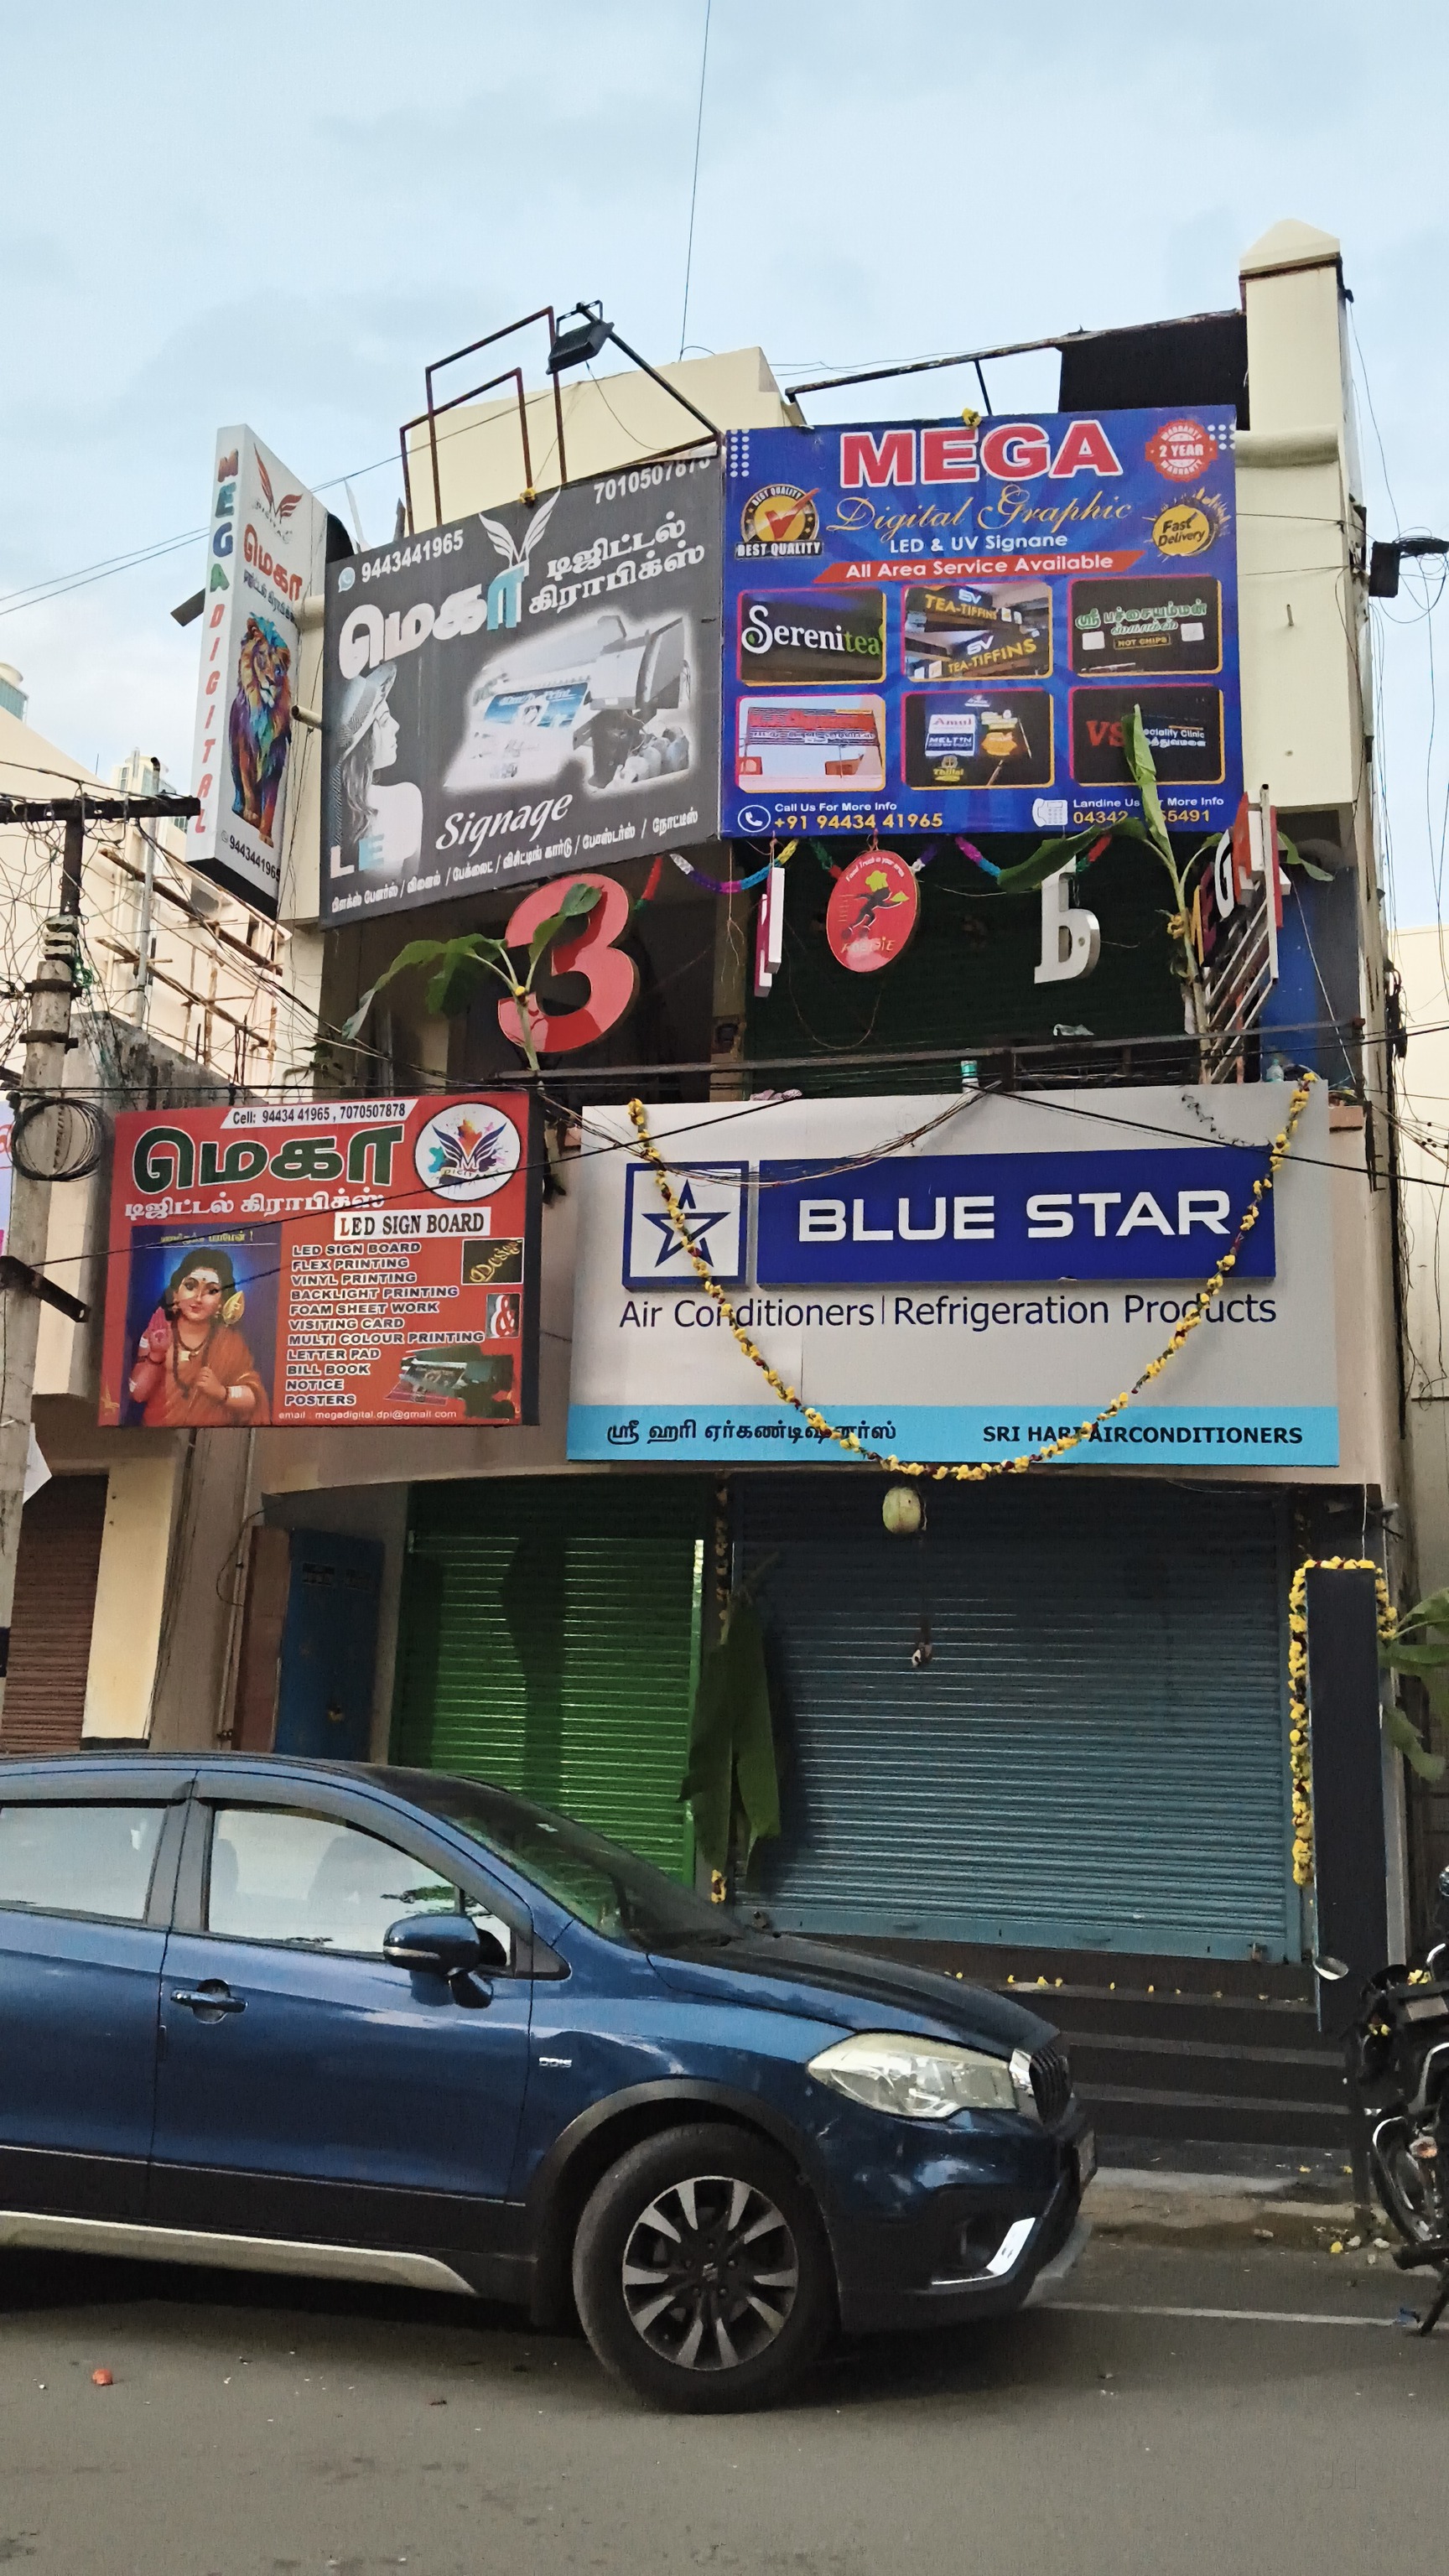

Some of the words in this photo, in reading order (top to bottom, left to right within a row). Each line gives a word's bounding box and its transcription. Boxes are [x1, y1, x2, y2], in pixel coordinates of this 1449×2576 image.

[840, 419, 1124, 488] MEGA
[1159, 445, 1167, 457] 2
[1171, 444, 1204, 457] YEAR
[751, 490, 769, 506] BEST
[771, 486, 802, 500] QUALITY
[825, 496, 974, 543] Digital
[977, 484, 1132, 533] Graphic
[1162, 512, 1199, 534] Fast
[547, 511, 686, 580] டிஜிட்டல்
[890, 538, 924, 553] LED
[931, 538, 943, 552] &
[951, 536, 979, 550] UV
[985, 534, 1068, 553] Signane
[1158, 530, 1206, 547] Delivery
[361, 529, 464, 583] 9443441965
[738, 543, 767, 557] BEST
[771, 542, 821, 556] QUALITY
[243, 523, 303, 601] மெகா
[846, 563, 870, 579] All
[877, 561, 927, 577] Area
[933, 559, 1008, 576] Service
[1015, 554, 1114, 572] Available
[528, 539, 705, 614] கிராபிக்ஸ்
[741, 605, 880, 655] Serenitea
[948, 638, 1037, 673] TEA-TIFFINS
[775, 803, 792, 813] Call
[800, 802, 816, 812] Us
[819, 802, 839, 812] For
[842, 802, 871, 812] More
[875, 802, 897, 811] Info
[1124, 798, 1140, 808] Us
[1167, 797, 1197, 807] More
[1201, 797, 1224, 806] Info
[435, 794, 573, 857] Signage
[775, 815, 807, 830] +91
[817, 814, 876, 829] 94434
[883, 813, 943, 828] 41965
[232, 1110, 257, 1125] Cell:
[262, 1109, 294, 1124] 94434
[297, 1108, 330, 1122] 41965
[340, 1103, 406, 1119] 7070507878
[132, 1124, 405, 1195] மெகா
[125, 1192, 235, 1221] டிஜிட்டல்
[240, 1187, 386, 1218] கிராபிக்ஸ்
[340, 1217, 376, 1236] LED
[382, 1215, 422, 1235] SIGN
[427, 1213, 485, 1233] BOARD
[798, 1195, 995, 1242] BLUE
[1026, 1190, 1231, 1239] STAR
[293, 1244, 322, 1257] LED
[325, 1243, 364, 1255] SIGN
[367, 1241, 422, 1254] BOARD
[292, 1259, 331, 1271] FLEX
[334, 1258, 409, 1270] PRINTING
[291, 1274, 338, 1286] VINYL
[341, 1272, 418, 1285] PRINTING
[291, 1288, 380, 1301] BACKLIGHT
[382, 1286, 460, 1299] PRINTING
[289, 1304, 334, 1316] FOAM
[335, 1302, 387, 1315] SHEET
[391, 1301, 440, 1314] WORK
[619, 1300, 663, 1328] Air
[894, 1293, 1109, 1332] Refrigeration
[288, 1319, 358, 1331] VISITING
[361, 1317, 405, 1329] CARD
[288, 1334, 337, 1346] MULTI
[339, 1332, 404, 1345] COLOUR
[408, 1331, 486, 1344] PRINTING
[287, 1348, 348, 1361] LETTER
[350, 1348, 382, 1360] PAD
[287, 1364, 321, 1376] BILL
[325, 1363, 371, 1375] BOOK
[285, 1379, 344, 1391] NOTICE
[284, 1394, 356, 1406] POSTERS
[278, 1410, 306, 1420] email
[647, 1419, 697, 1444] ஹரி
[983, 1426, 1021, 1442] SRI
[1088, 1425, 1302, 1444] AIRCONDITIONERS
